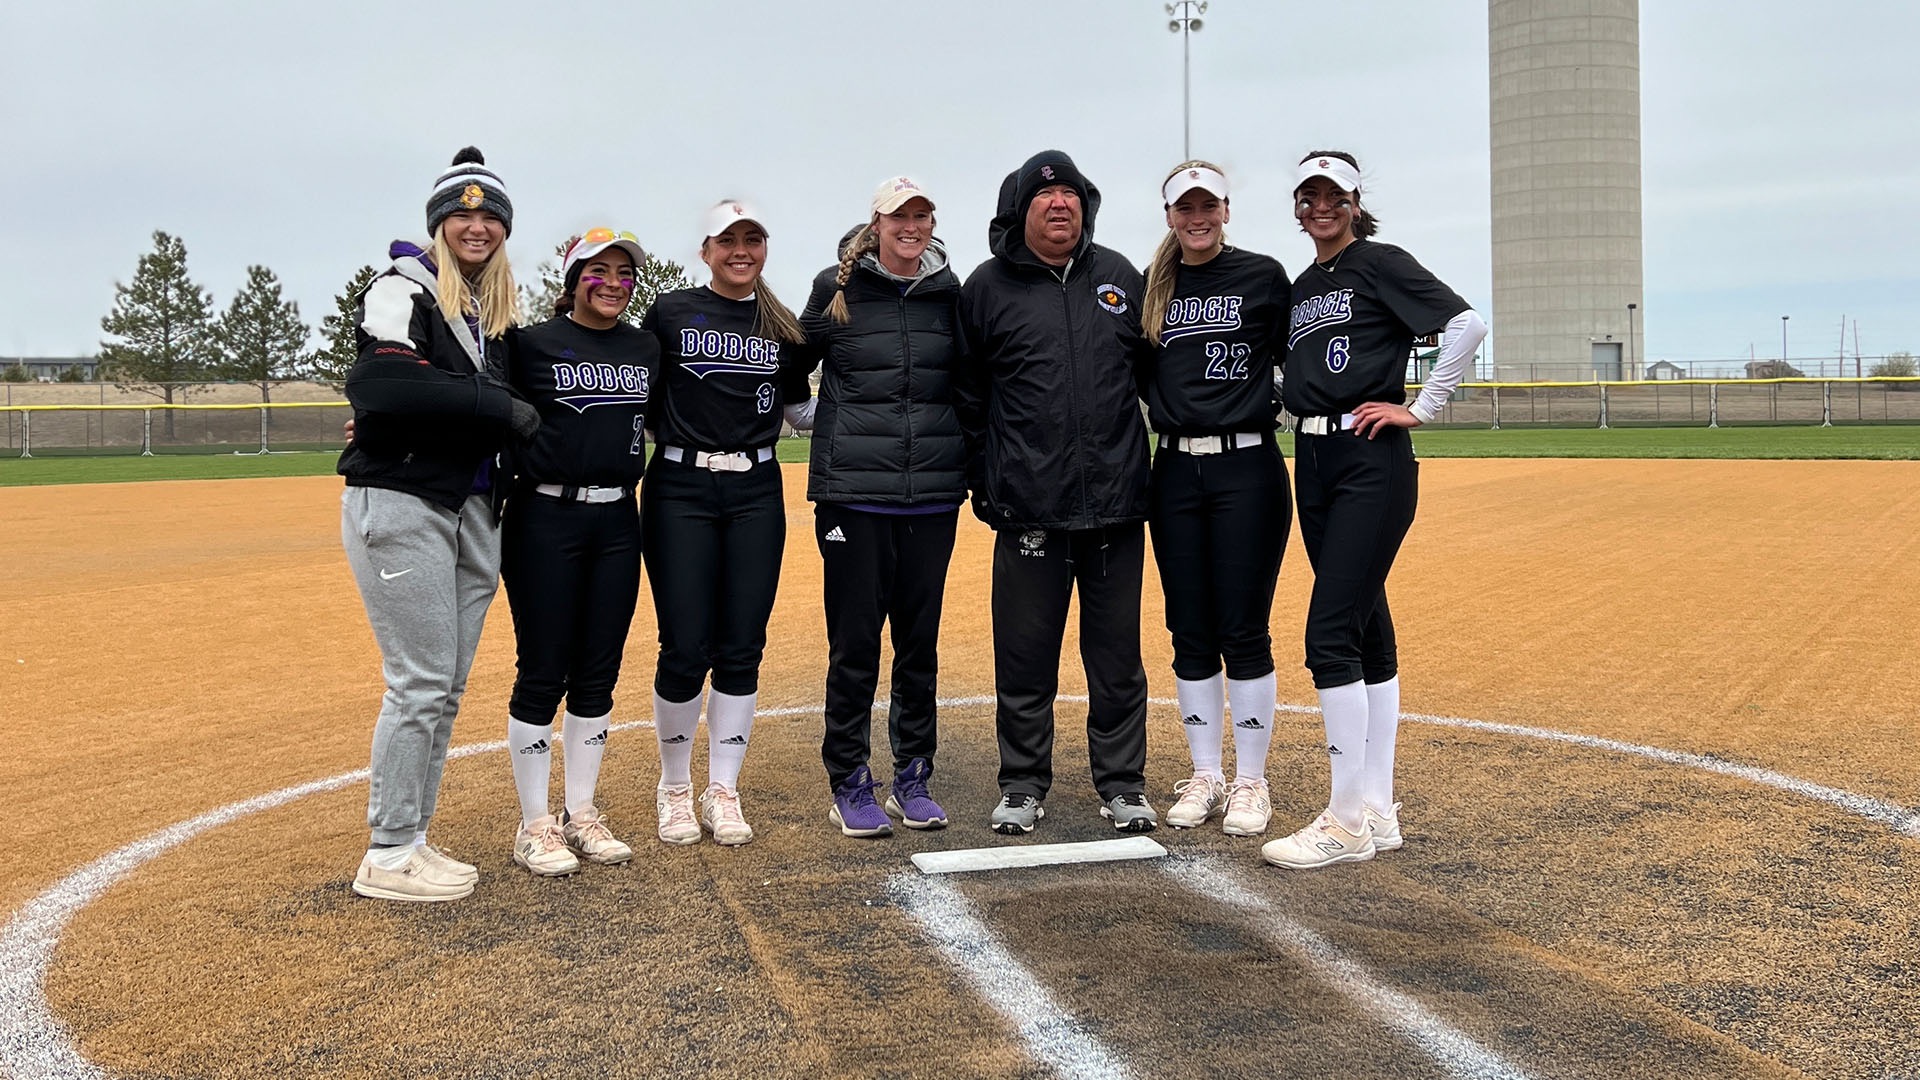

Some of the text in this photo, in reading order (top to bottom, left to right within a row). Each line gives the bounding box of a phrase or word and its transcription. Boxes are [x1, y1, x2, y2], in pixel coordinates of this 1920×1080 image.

[1165, 296, 1243, 326] ODGE
[1287, 288, 1354, 335] DODGE
[680, 328, 780, 367] DODGE
[1205, 341, 1252, 380] 22
[1325, 335, 1351, 374] 6
[552, 362, 650, 395] DODGE
[755, 382, 776, 414] 9
[629, 414, 645, 455] 2
